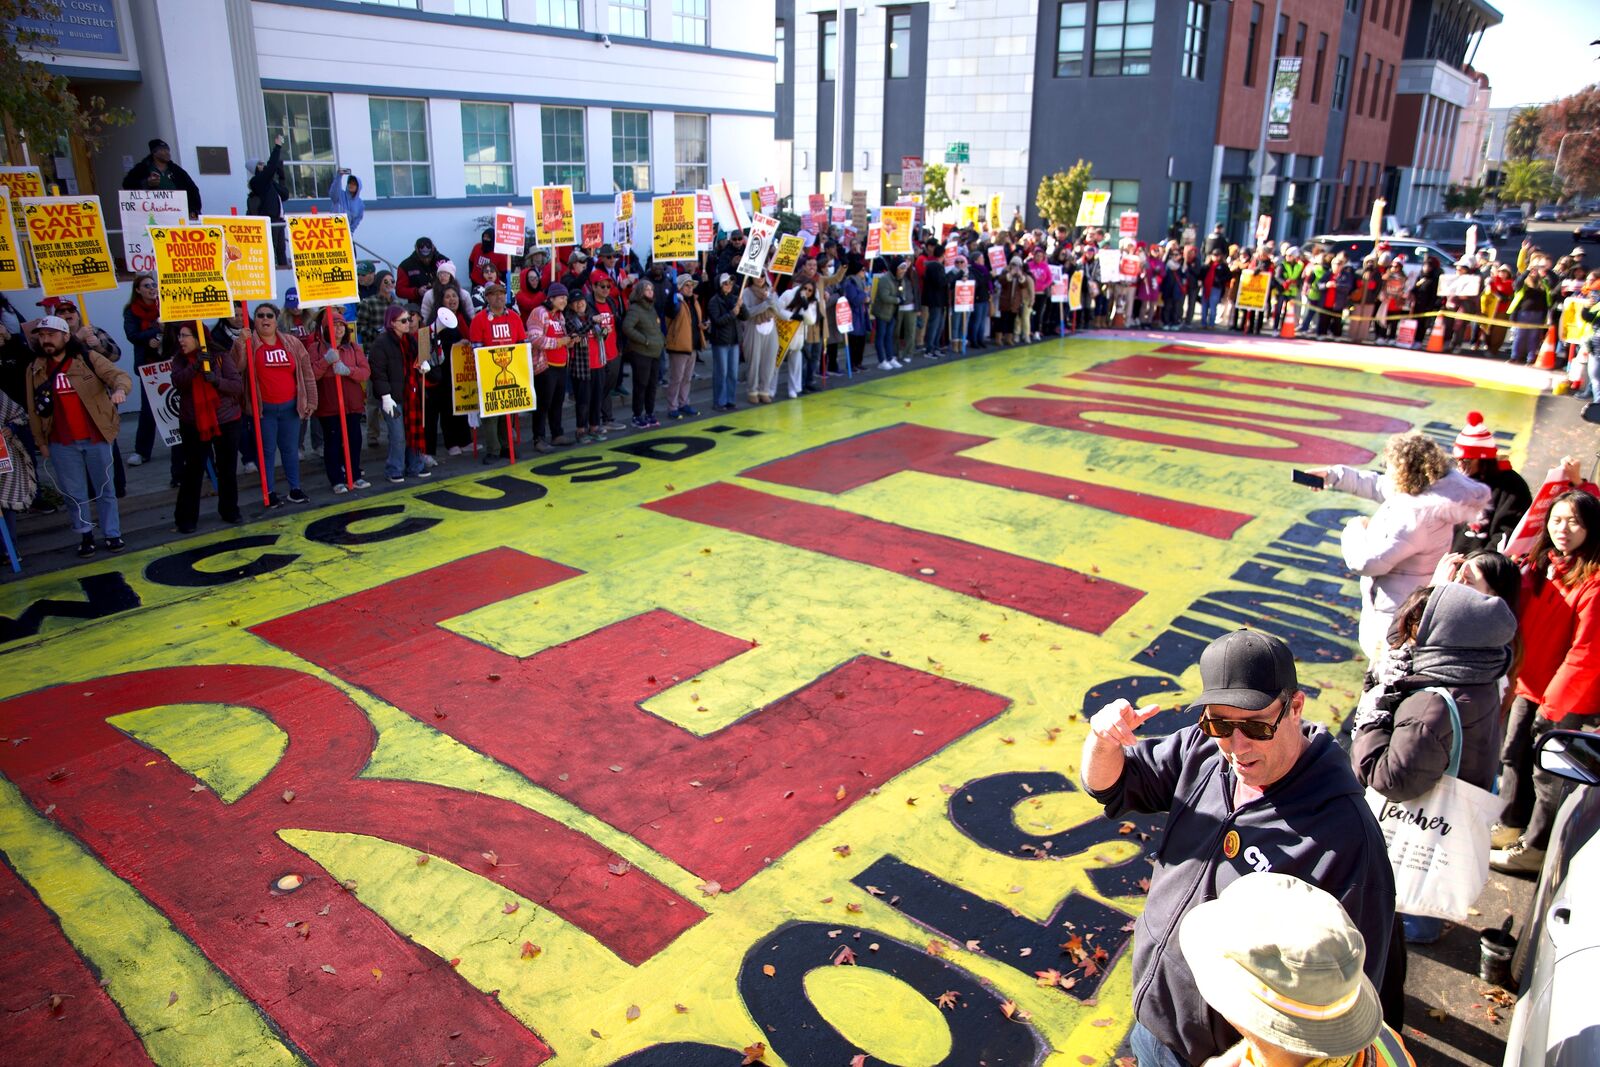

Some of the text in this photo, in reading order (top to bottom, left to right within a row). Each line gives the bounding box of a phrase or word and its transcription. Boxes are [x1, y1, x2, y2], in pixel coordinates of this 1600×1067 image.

[70, 15, 115, 28] DISTRICT
[130, 191, 174, 200] ALL I WANT
[121, 201, 182, 212] FOR Christmas
[662, 198, 684, 207] SUELDO
[42, 205, 80, 217] WE
[664, 207, 682, 215] JUSTO
[30, 214, 97, 230] CAN'T
[302, 218, 333, 228] WE
[663, 215, 674, 223] PARA
[229, 225, 261, 234] CAN'T
[502, 223, 520, 231] STRIKE
[655, 222, 694, 232] EDUCADORES
[33, 226, 95, 241] WAIT
[170, 230, 205, 242] NO
[234, 235, 262, 244] WAIT
[292, 227, 346, 240] CAN'T
[33, 240, 100, 252] INVEST IN THE SCHOOLS
[129, 243, 141, 253] IS
[166, 242, 216, 257] PODEMOS
[249, 246, 263, 255] for
[295, 239, 345, 251] WAIT
[36, 247, 104, 259] OUR STUDENTS DESERVE
[294, 253, 310, 261] INVEST
[326, 250, 346, 258] SCHOOLS
[172, 257, 215, 273] ESPERAR
[329, 257, 349, 265] DESERVE
[492, 323, 511, 338] UTR
[265, 349, 289, 363] UTR
[142, 365, 158, 376] WE
[486, 387, 527, 401] FULLY STAFF
[485, 397, 530, 412] OUR SCHOOLS
[165, 437, 176, 445] OUR
[1379, 799, 1452, 836] Teacher
[1243, 845, 1272, 872] CT
